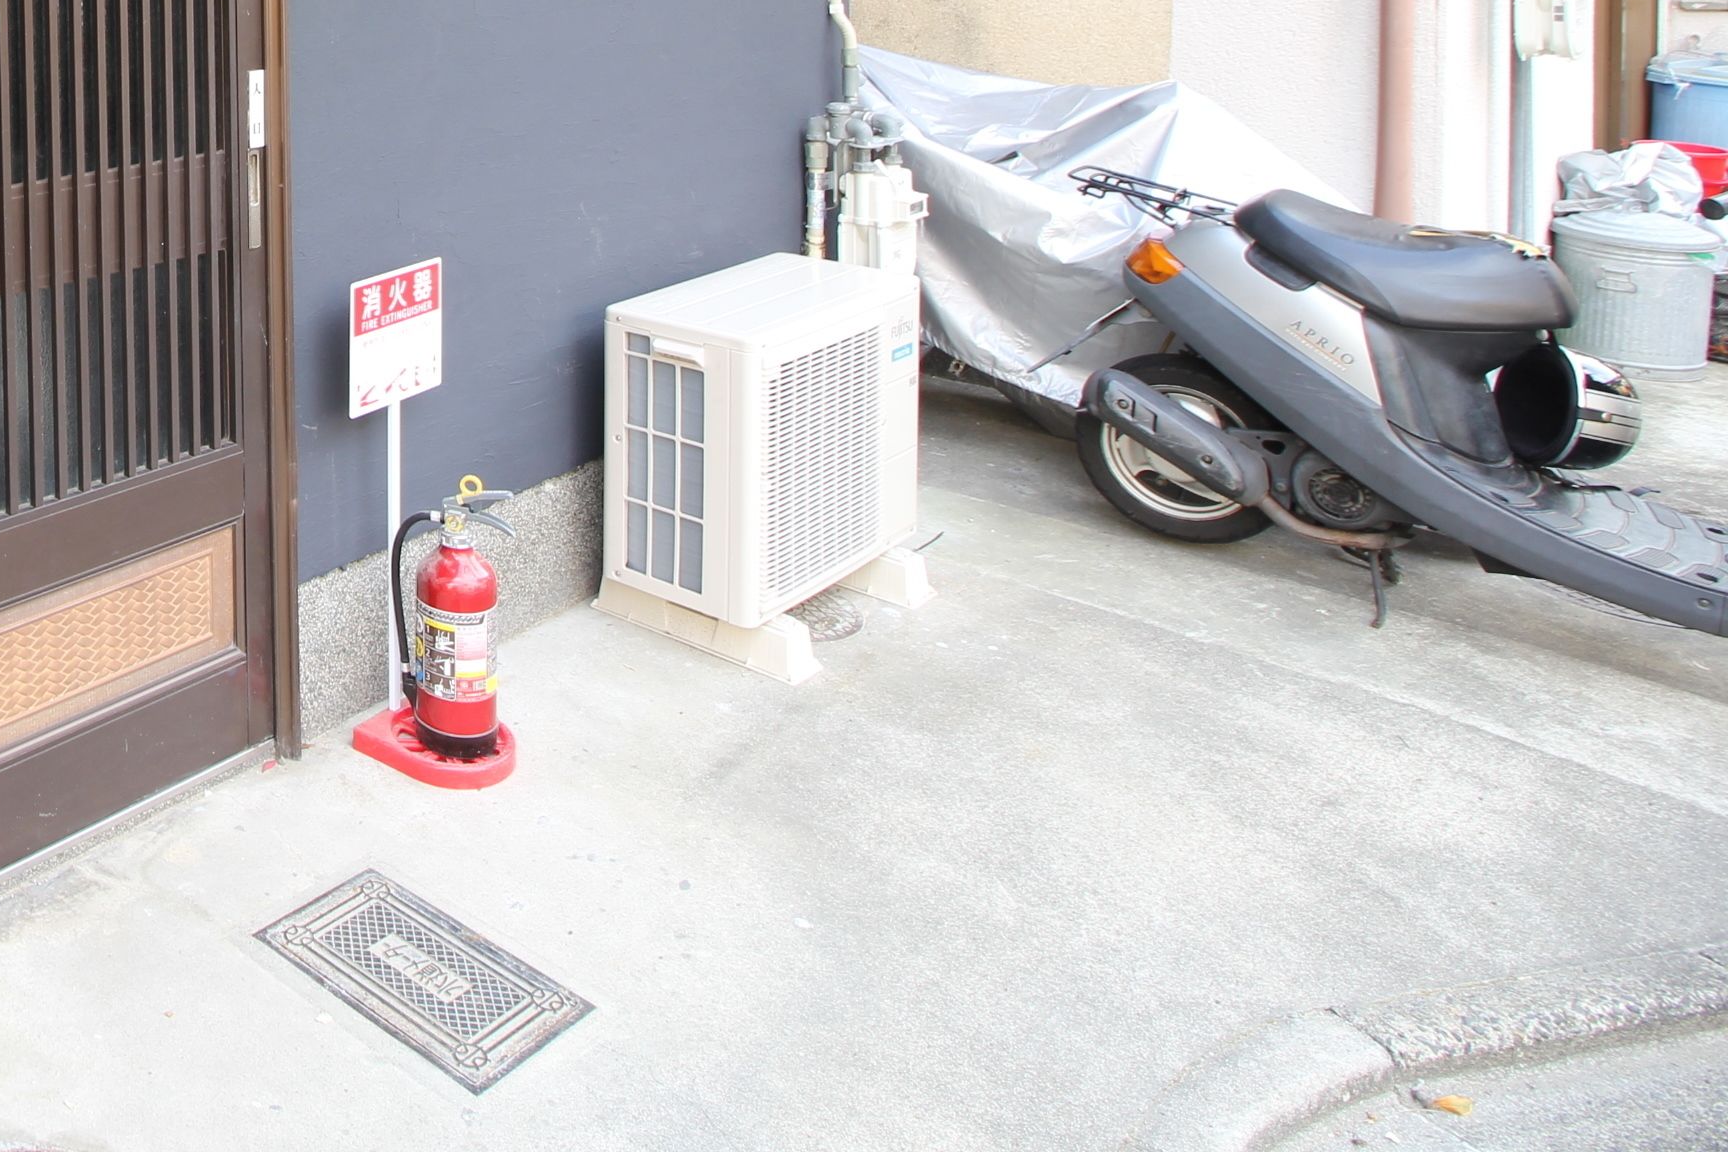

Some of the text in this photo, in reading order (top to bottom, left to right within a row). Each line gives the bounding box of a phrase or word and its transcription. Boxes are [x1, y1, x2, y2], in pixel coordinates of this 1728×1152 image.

[361, 269, 433, 320] 消火器
[361, 300, 432, 333] FIRE EXTINGUISHER
[1289, 319, 1354, 365] APRIO
